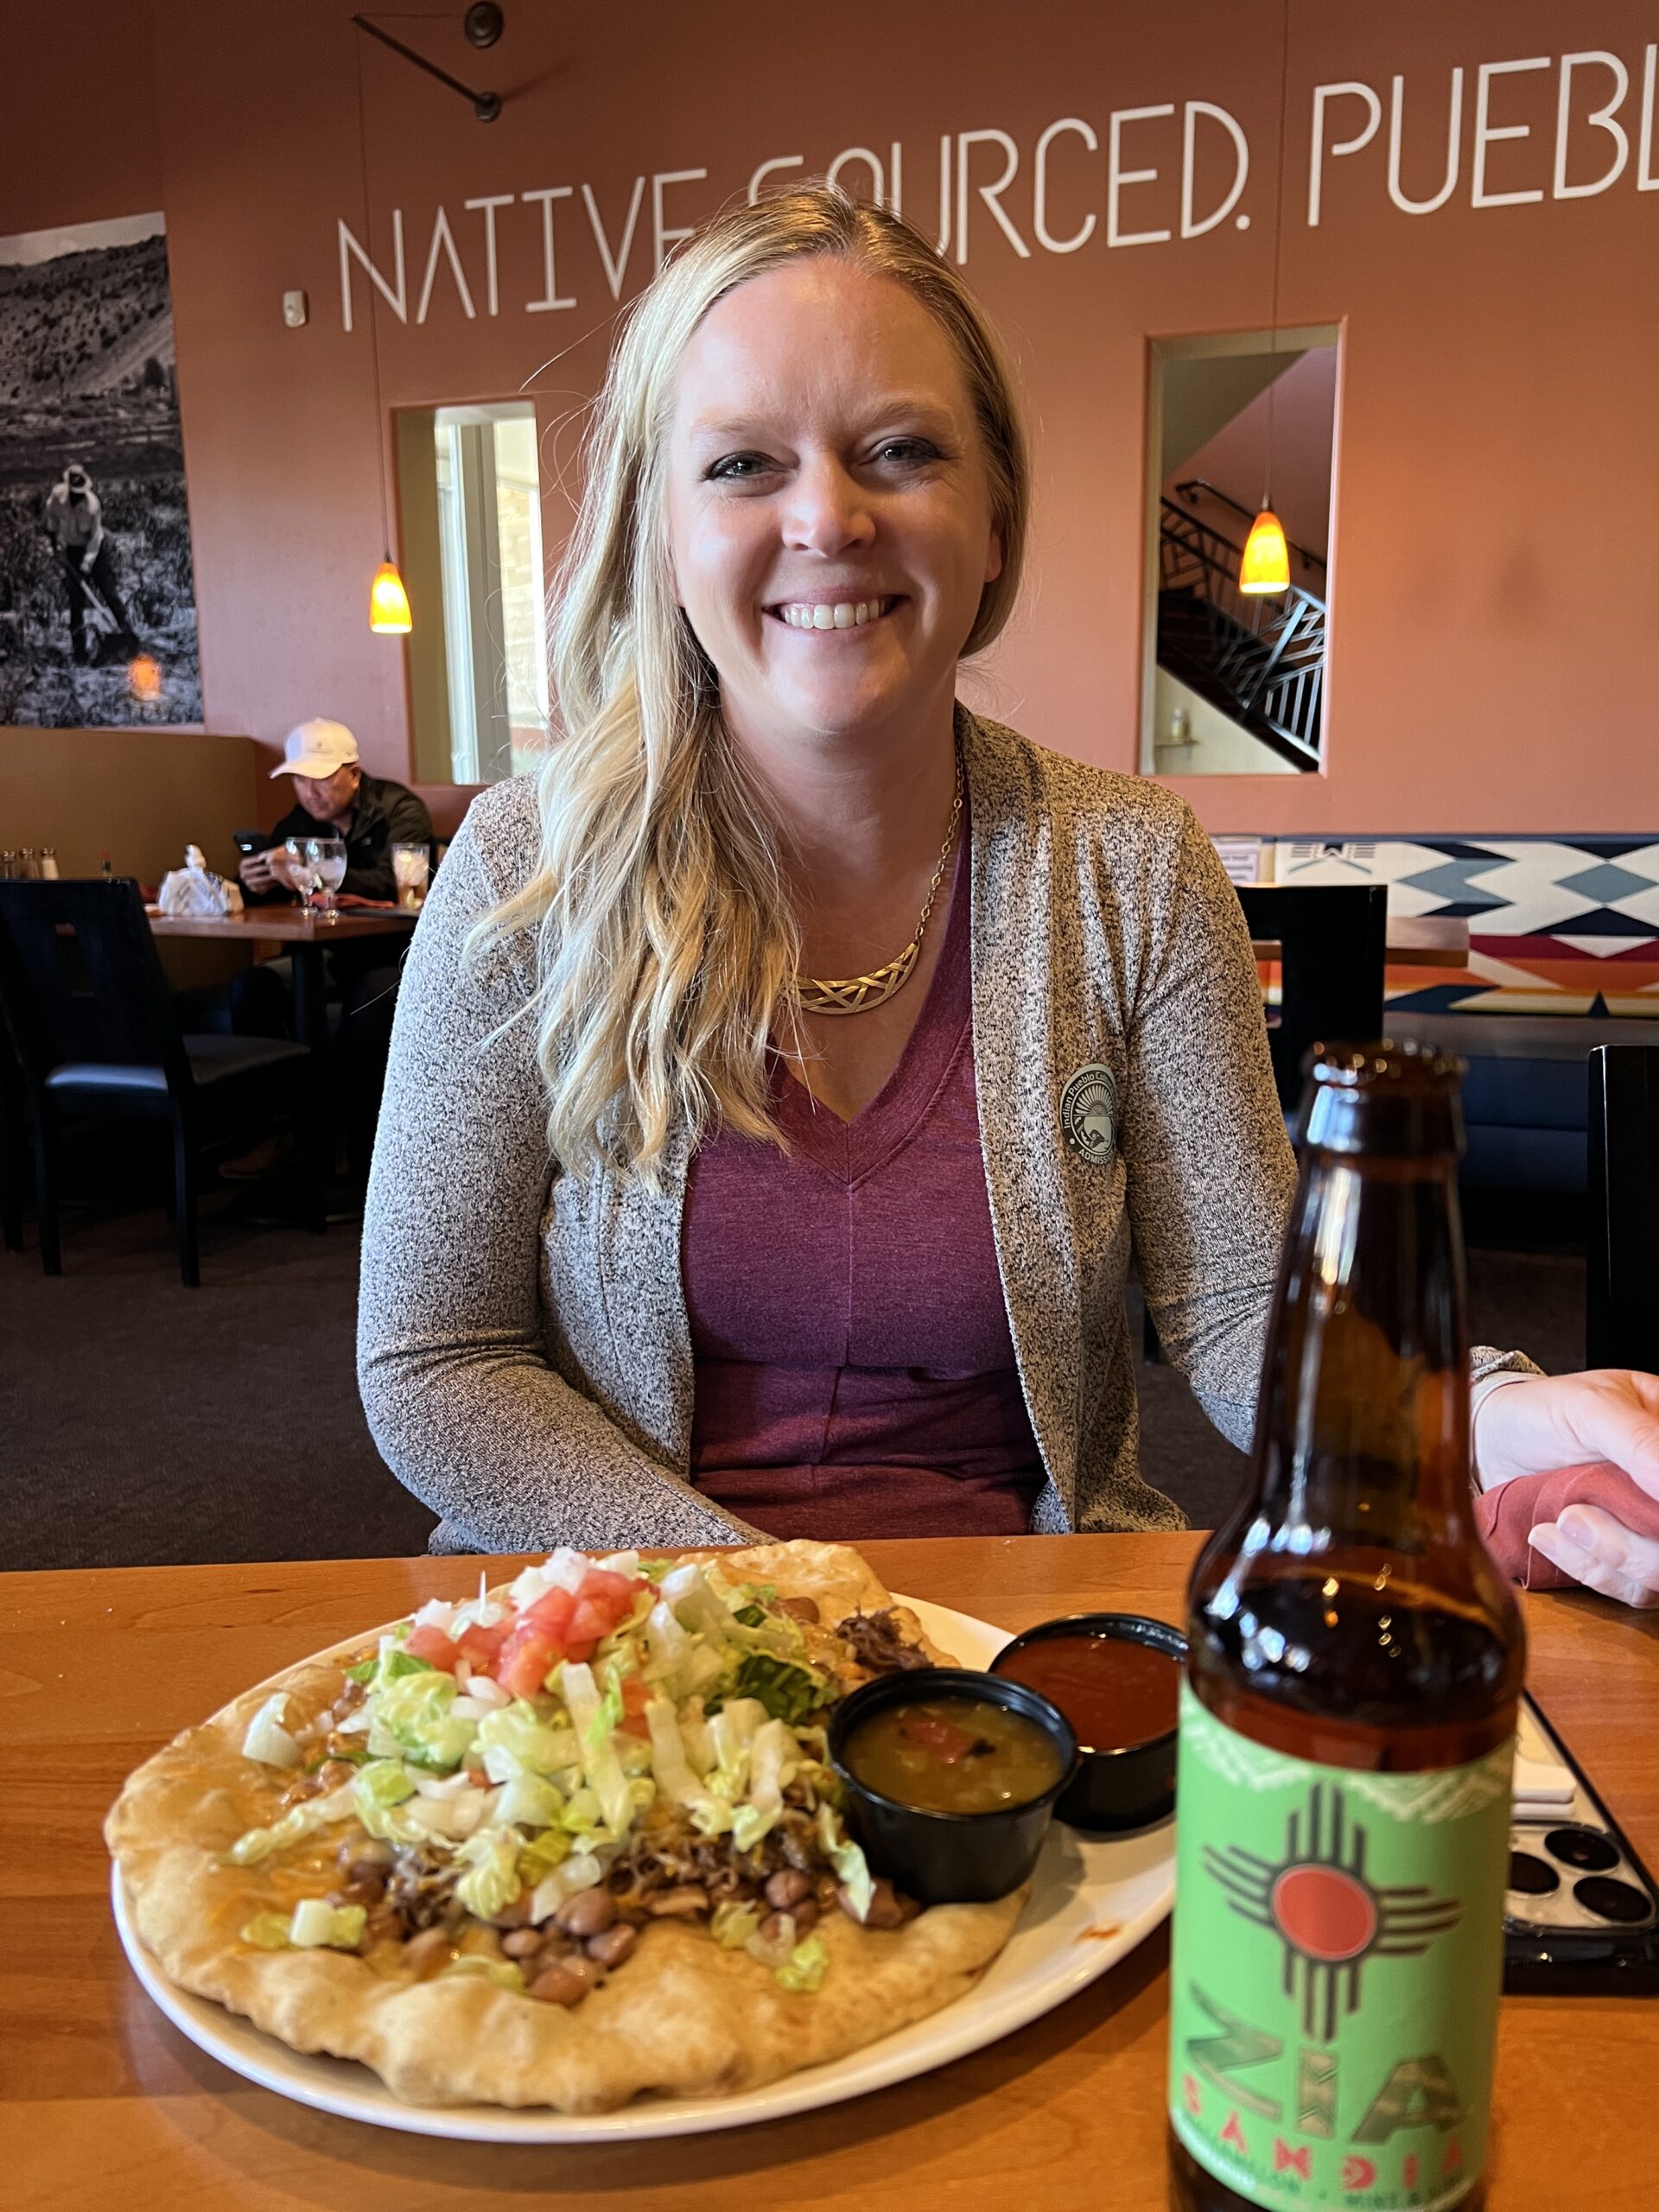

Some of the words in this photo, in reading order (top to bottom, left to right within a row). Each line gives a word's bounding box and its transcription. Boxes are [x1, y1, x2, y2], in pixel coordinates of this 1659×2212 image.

[338, 168, 708, 332] NATIVE
[1062, 1096, 1073, 1129] Indian
[1068, 1073, 1095, 1096] Pueblo
[1183, 2071, 1463, 2190] SANDIA
[1185, 1979, 1465, 2145] ZIA
